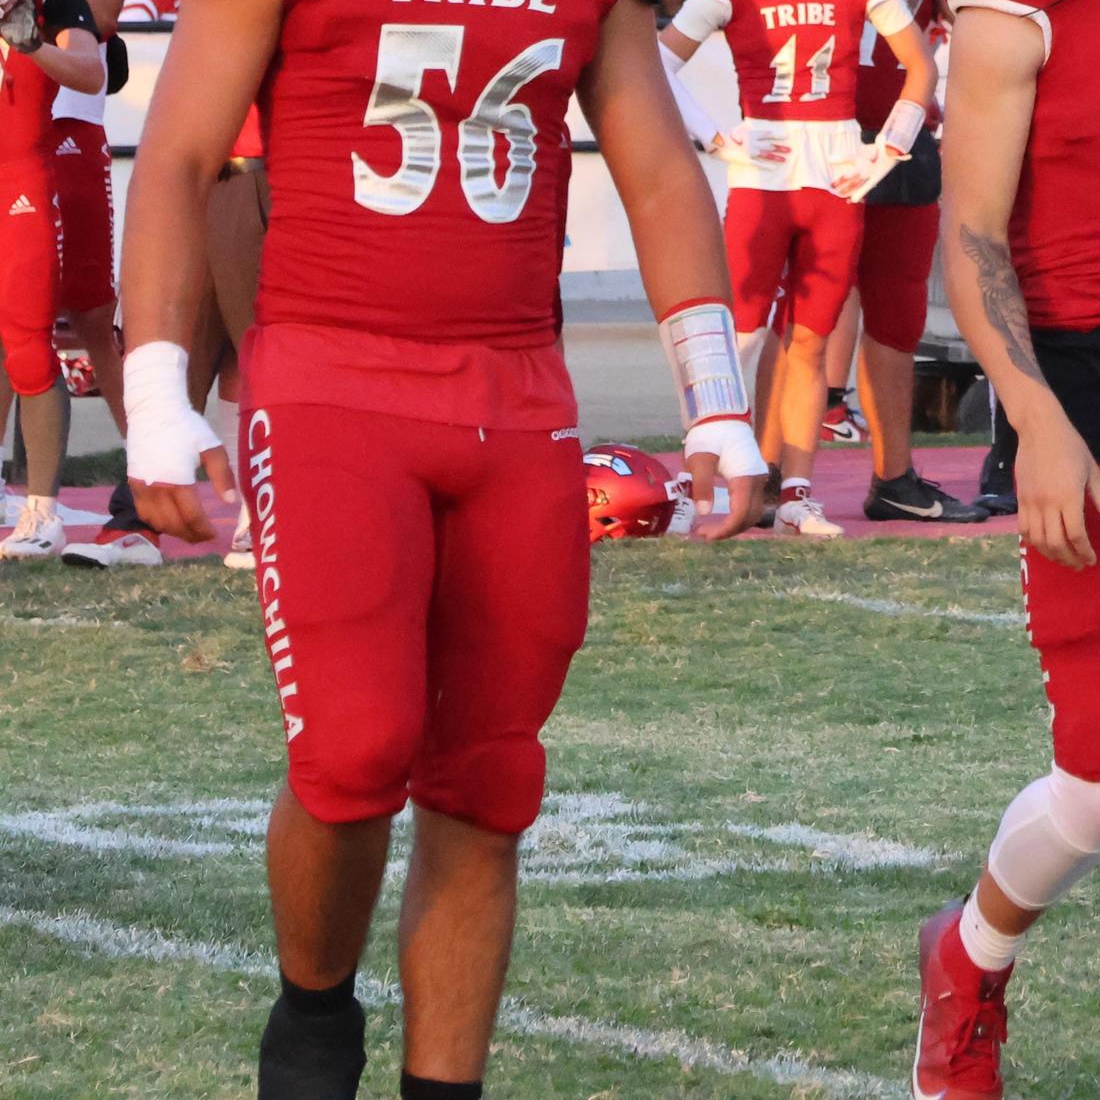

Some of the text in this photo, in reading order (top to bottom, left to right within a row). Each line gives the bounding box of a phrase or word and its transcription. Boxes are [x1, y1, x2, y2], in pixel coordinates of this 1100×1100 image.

[759, 2, 836, 30] TRIBE
[762, 33, 836, 104] 11
[351, 23, 566, 224] 56
[248, 409, 304, 744] CHOWCHILLA
